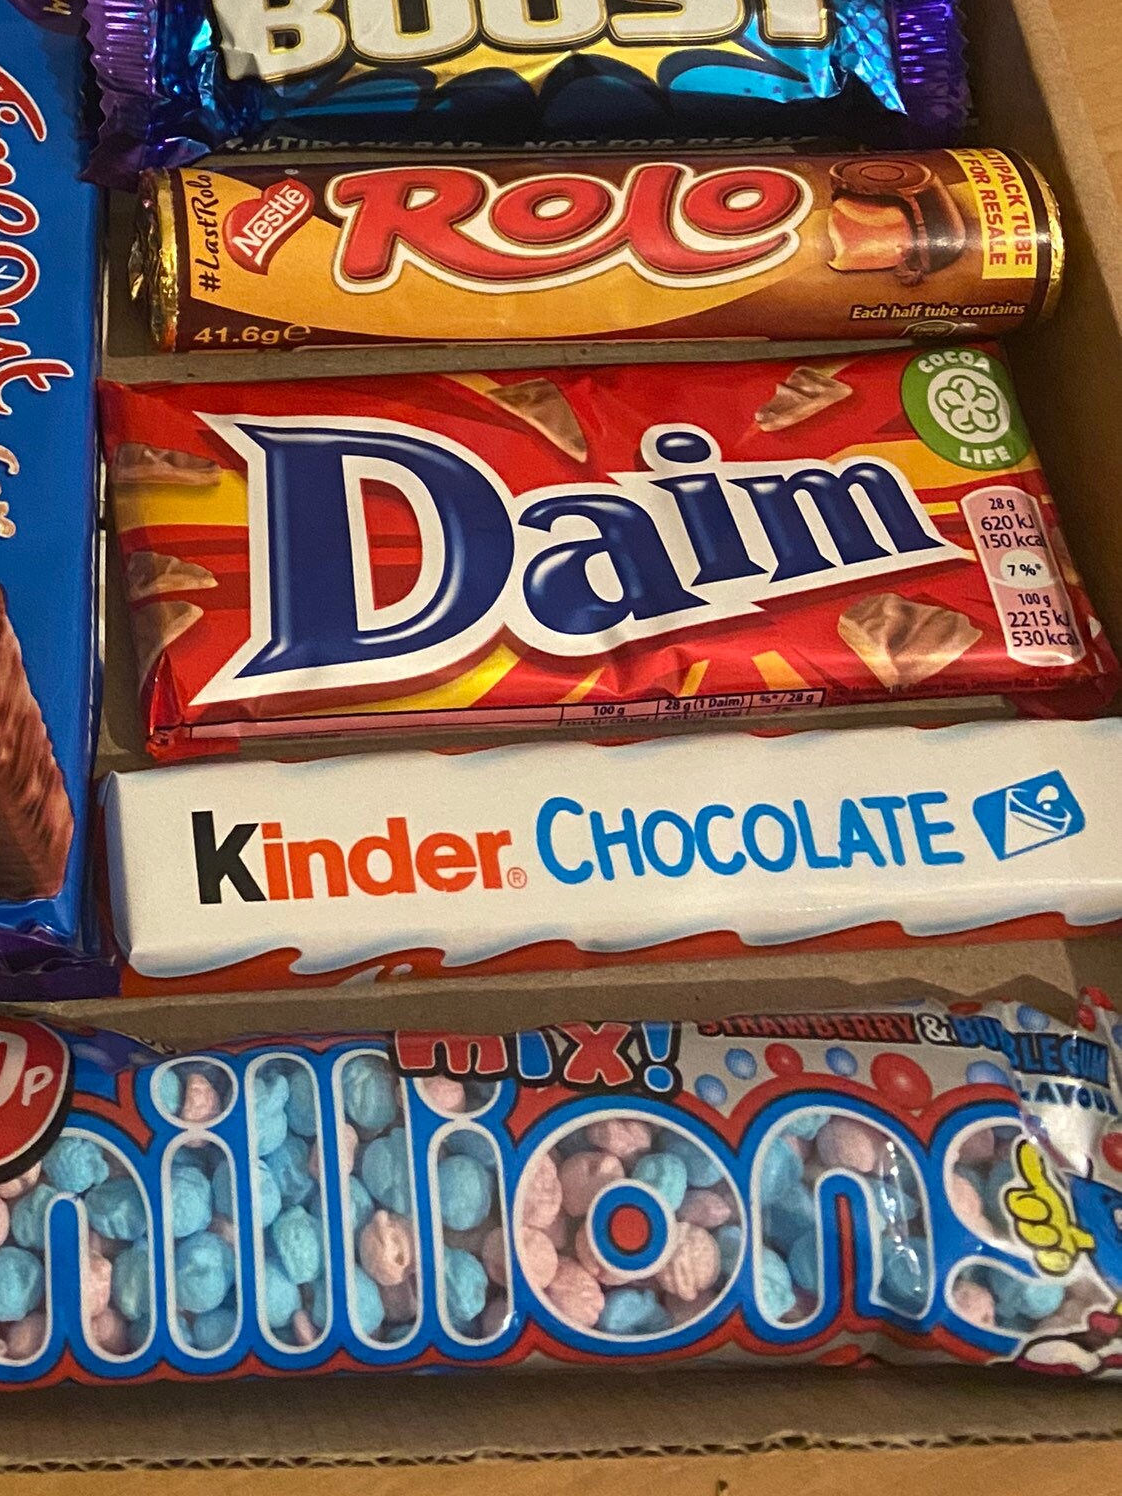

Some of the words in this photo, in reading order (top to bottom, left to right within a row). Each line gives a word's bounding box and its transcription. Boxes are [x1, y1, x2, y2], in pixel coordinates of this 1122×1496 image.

[964, 159, 992, 185] FOR
[978, 190, 1007, 266] RESALE
[185, 175, 221, 292] #LastRolo
[1010, 211, 1033, 266] TUBE
[852, 306, 887, 320] Each
[891, 305, 921, 319] half
[924, 304, 958, 318] tube
[962, 302, 1026, 317] contains
[917, 350, 991, 374] COCOA
[959, 445, 1012, 465] LIFE
[988, 497, 1004, 510] 28
[980, 515, 1013, 531] 620
[980, 533, 1012, 549] 150
[1013, 531, 1048, 549] kcal
[213, 416, 950, 688] Daim
[1017, 593, 1040, 606] 100
[1007, 610, 1051, 628] 2215
[1011, 630, 1044, 647] 530
[1046, 628, 1080, 647] kcal
[593, 705, 615, 717] 100
[664, 699, 681, 712] 28
[536, 792, 966, 884] CHOCOLATE
[698, 1012, 921, 1044] STRAWBERRY
